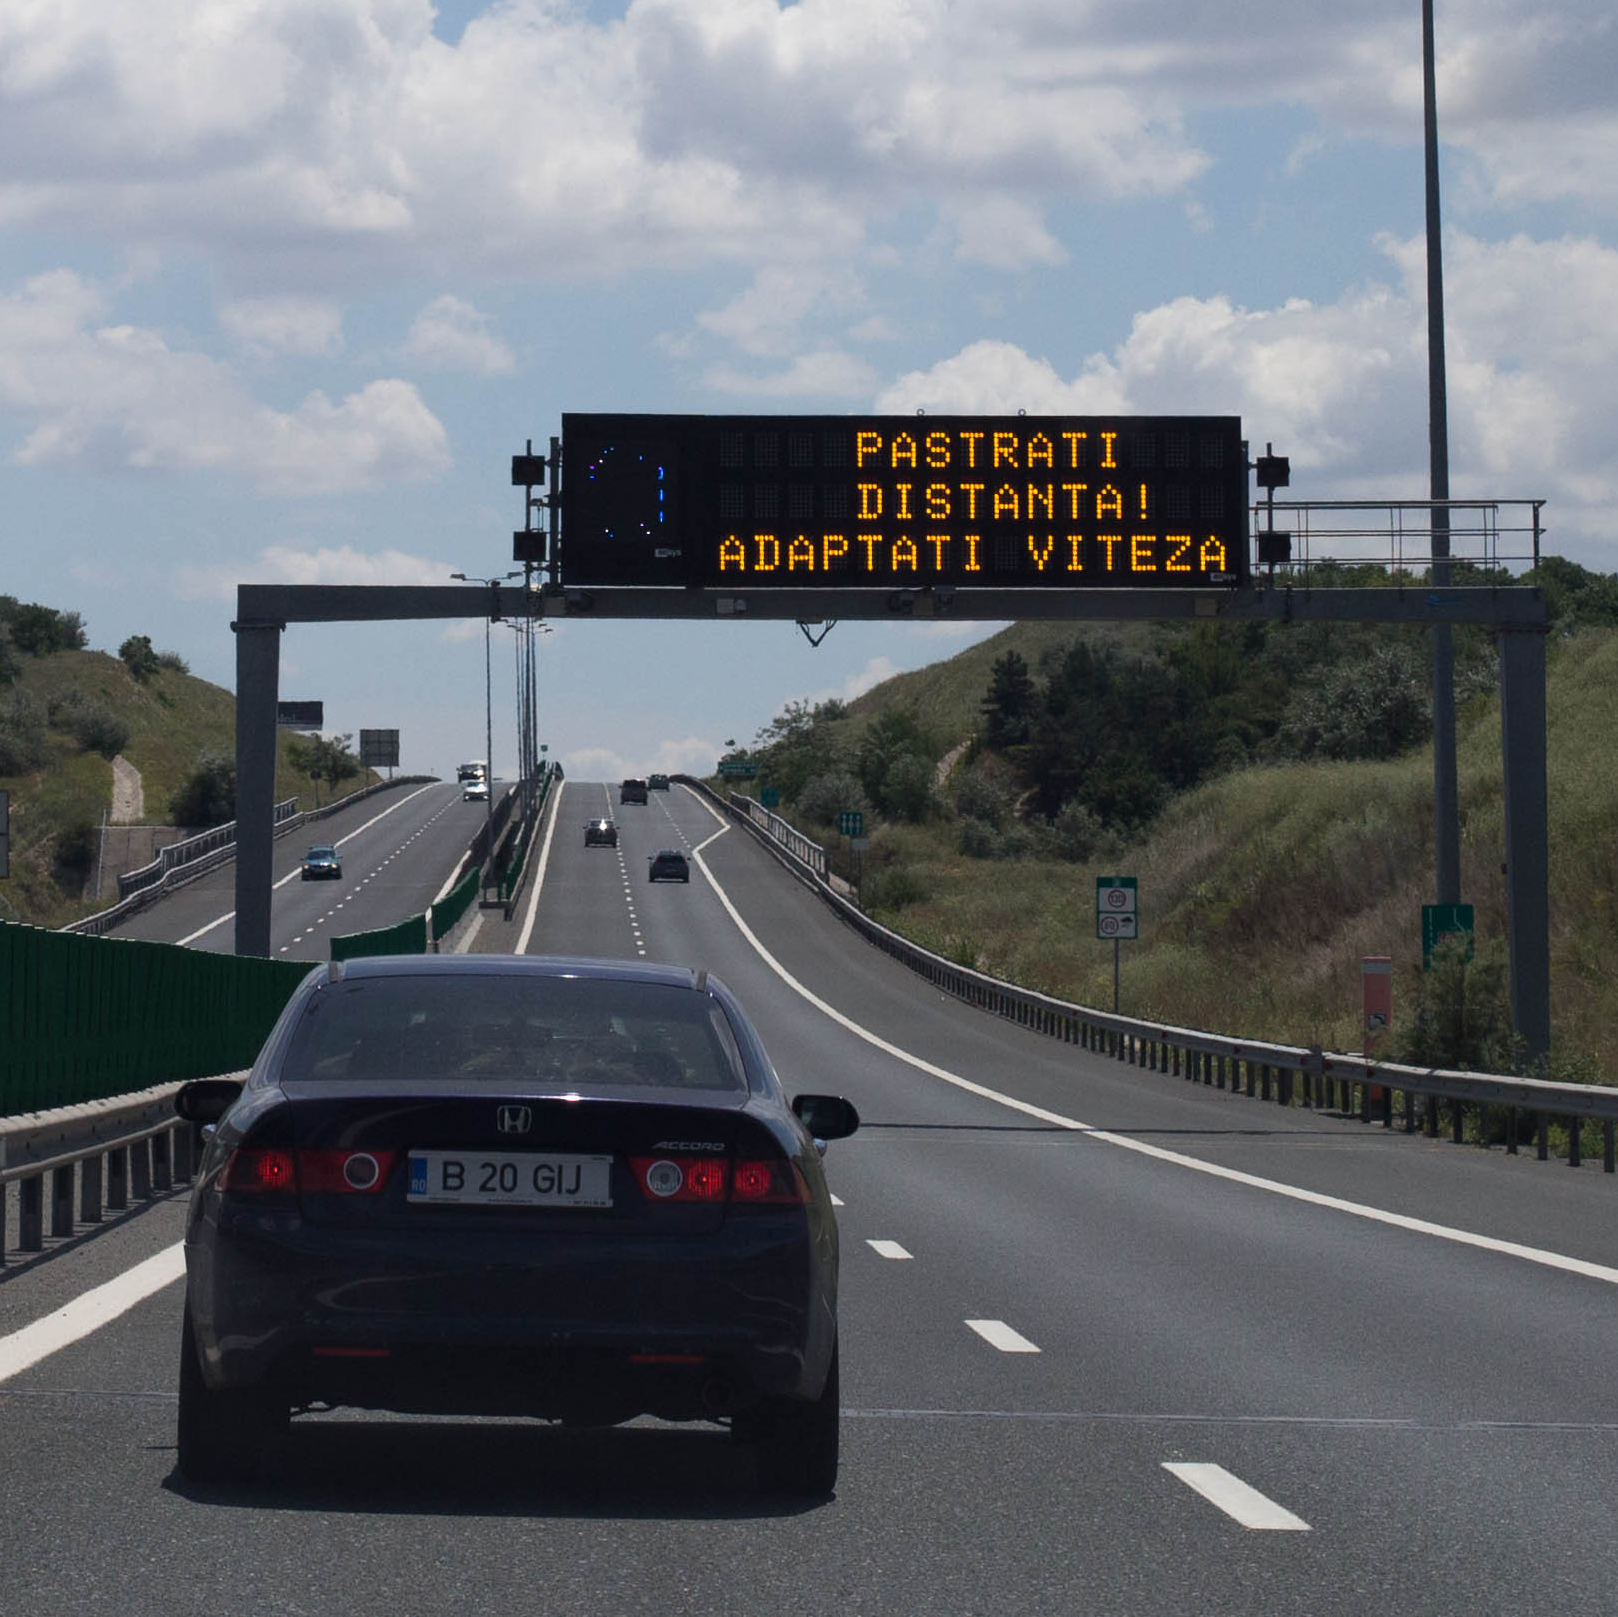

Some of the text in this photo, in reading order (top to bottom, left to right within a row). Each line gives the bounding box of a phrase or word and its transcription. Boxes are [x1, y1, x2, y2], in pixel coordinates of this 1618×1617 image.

[856, 431, 1117, 469] PASTRATI
[857, 483, 1147, 520] DISTANTA!
[719, 534, 1226, 572] ADAPTATI VITEZA
[651, 1141, 726, 1151] ACCORD
[411, 1179, 427, 1192] RO
[442, 1160, 582, 1195] B 20 GIJ
